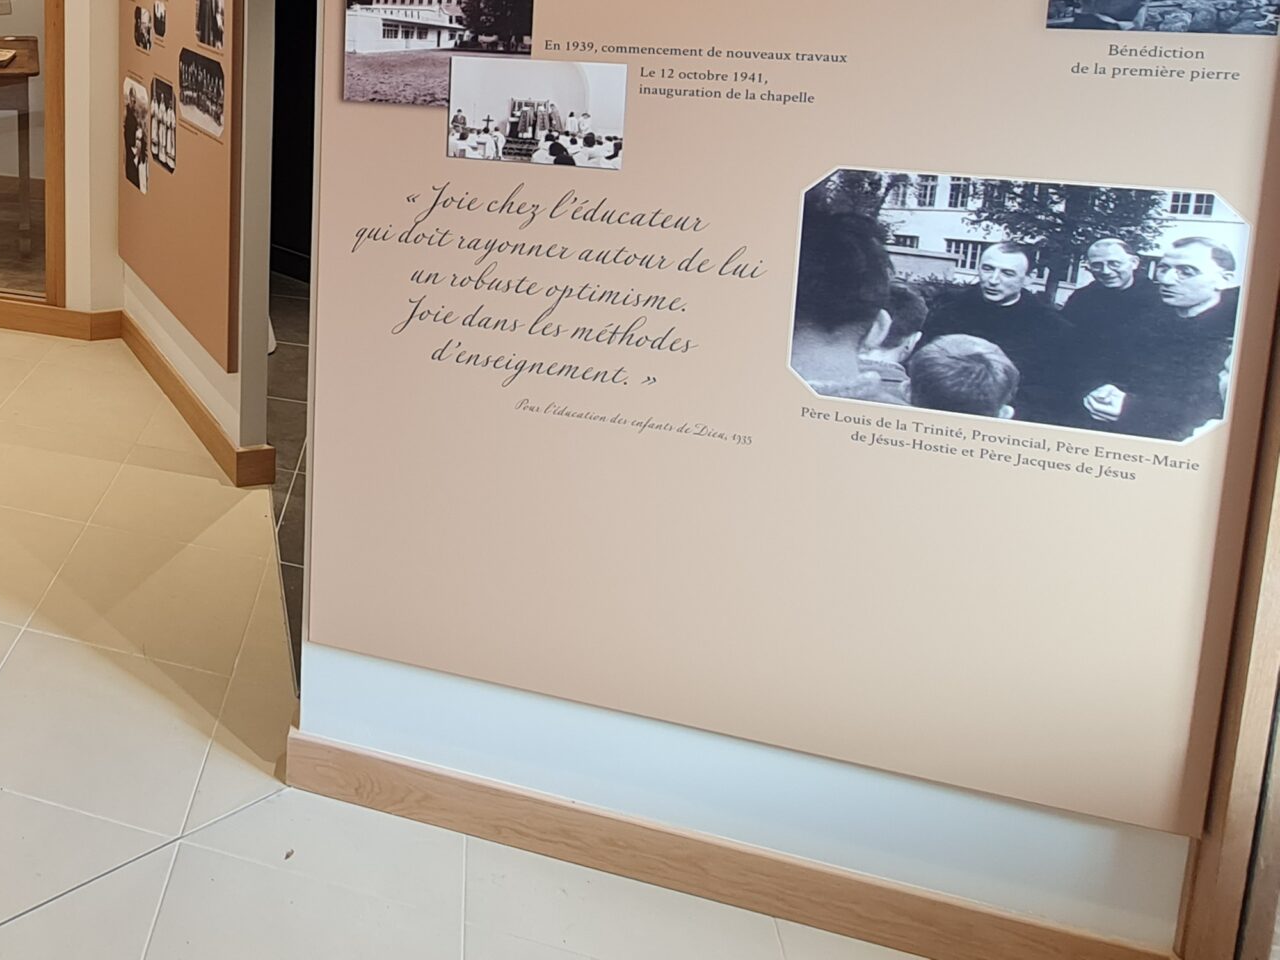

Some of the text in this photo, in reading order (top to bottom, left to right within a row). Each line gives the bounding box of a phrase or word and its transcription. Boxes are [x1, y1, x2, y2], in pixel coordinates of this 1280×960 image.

[544, 40, 848, 63] En 1939, commencement de nouveaux travaux
[640, 67, 768, 85] Le 12 octobre 1941,
[1070, 62, 1241, 84] de la première pierre
[1108, 44, 1205, 61] Bénédiction
[639, 84, 814, 104] inauguration de la chapelle
[414, 182, 483, 223] Joie
[487, 182, 546, 229] chez
[548, 189, 710, 232] l'éducateur
[351, 221, 767, 279] qui doit rayonner autour de lui
[410, 261, 687, 313] un robuste optimisme.
[391, 295, 699, 354] Joie dans les méthodes
[431, 339, 629, 388] d'enseignement.
[515, 398, 541, 413] Pour
[609, 414, 629, 426] des
[630, 416, 674, 437] enfants
[675, 421, 694, 433] de
[801, 407, 1200, 471] Père Louis de la Trinité, Provincial, Père Ernest-Marie
[850, 431, 1136, 481] de Jésus-Hostie et Père Jacques de Jésus
